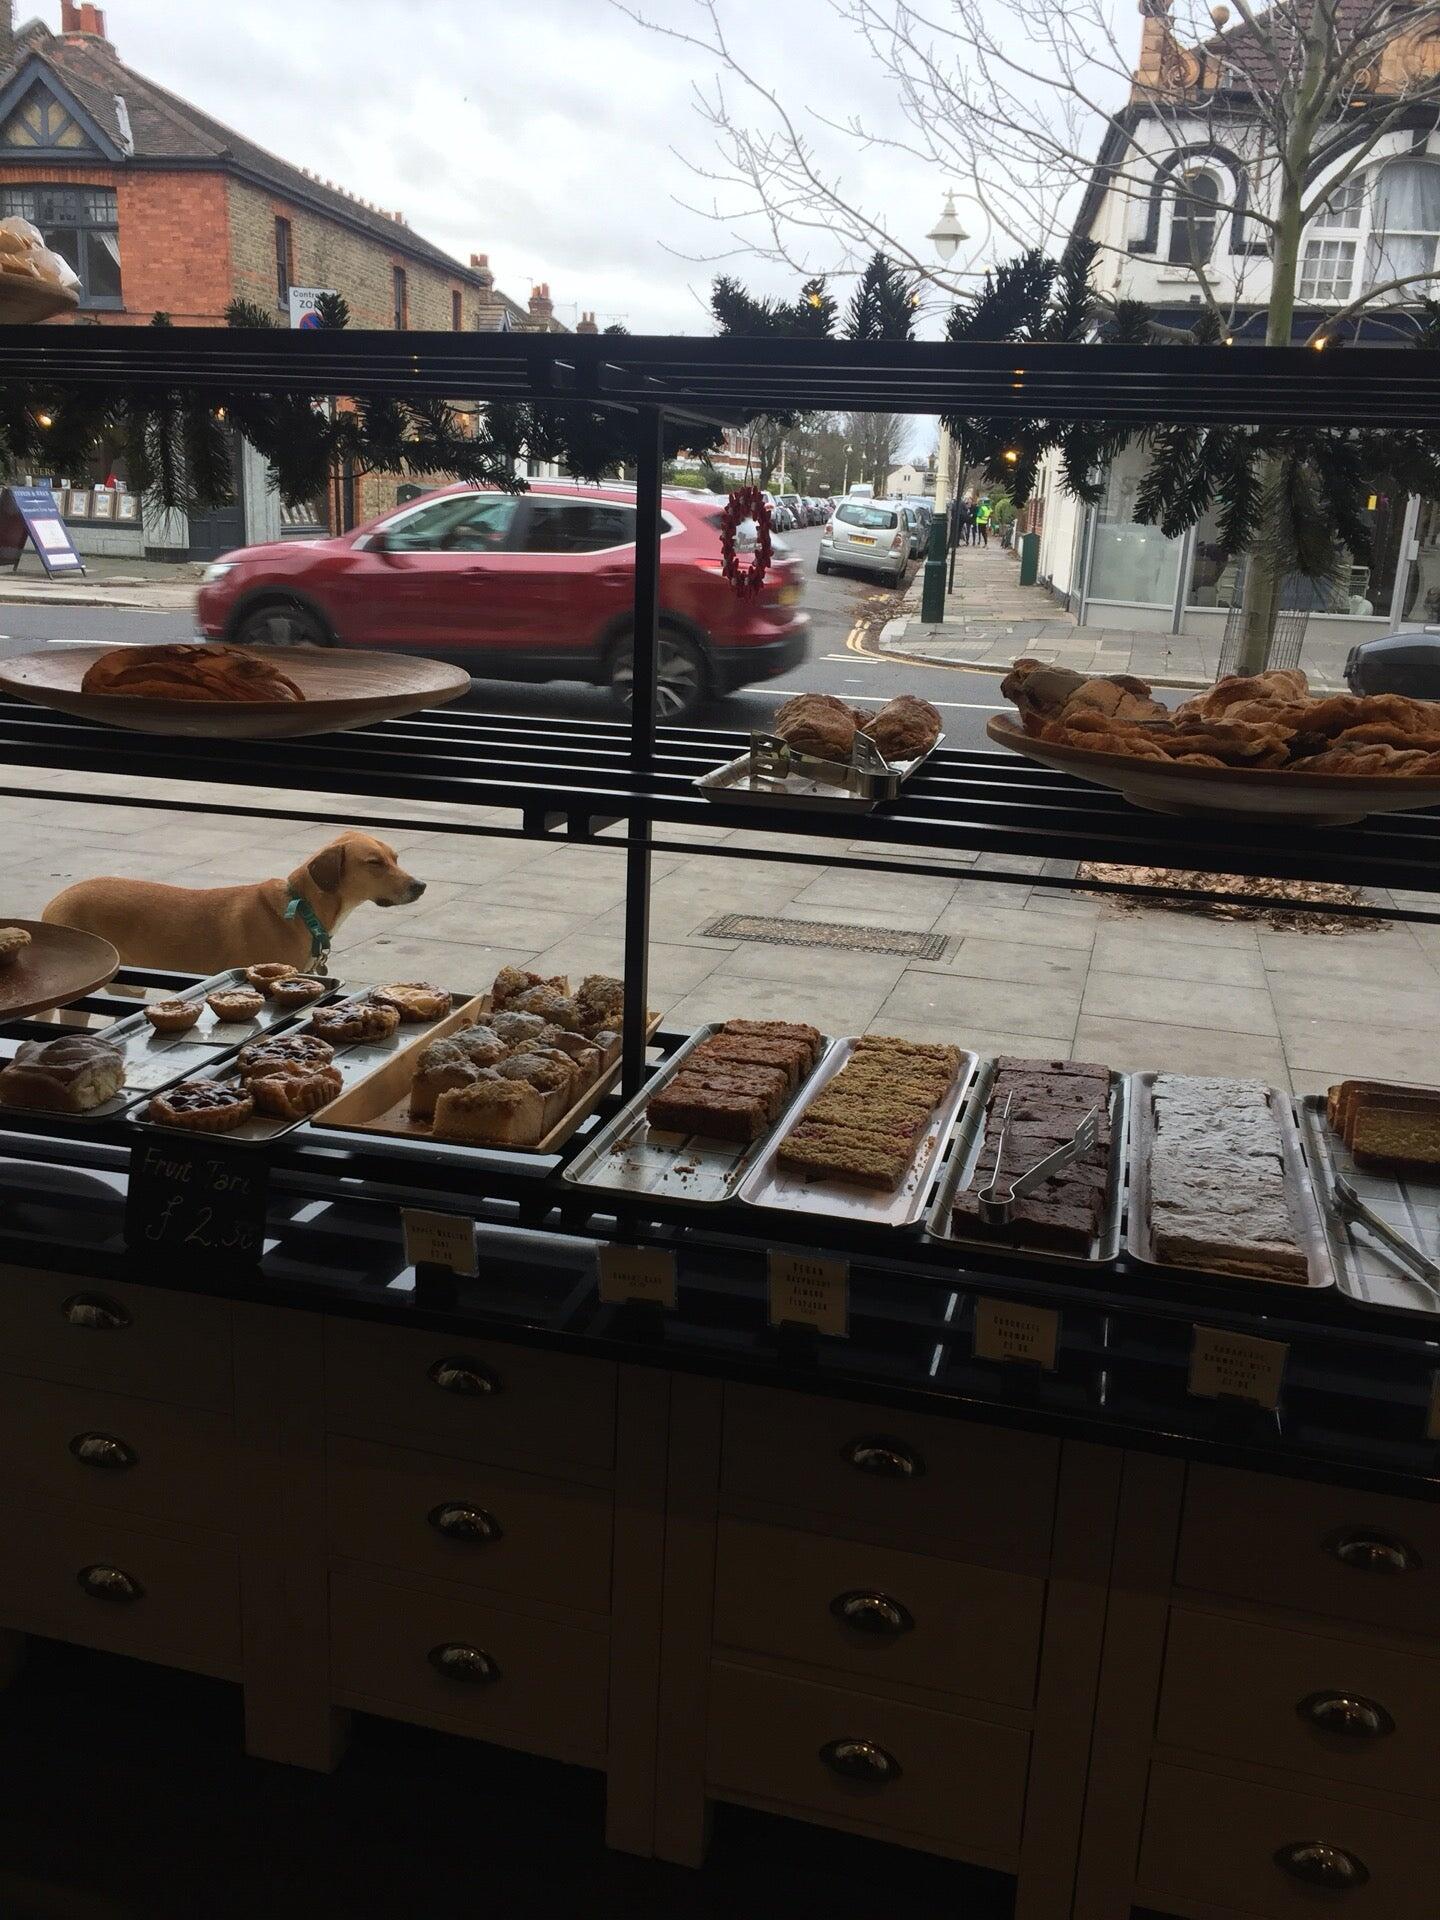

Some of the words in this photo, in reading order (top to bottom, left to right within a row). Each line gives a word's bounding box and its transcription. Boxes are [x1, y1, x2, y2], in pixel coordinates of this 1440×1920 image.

[293, 290, 319, 298] Contro
[16, 465, 56, 476] VALUERS
[143, 1147, 193, 1182] Fruit
[207, 1160, 250, 1195] Tart
